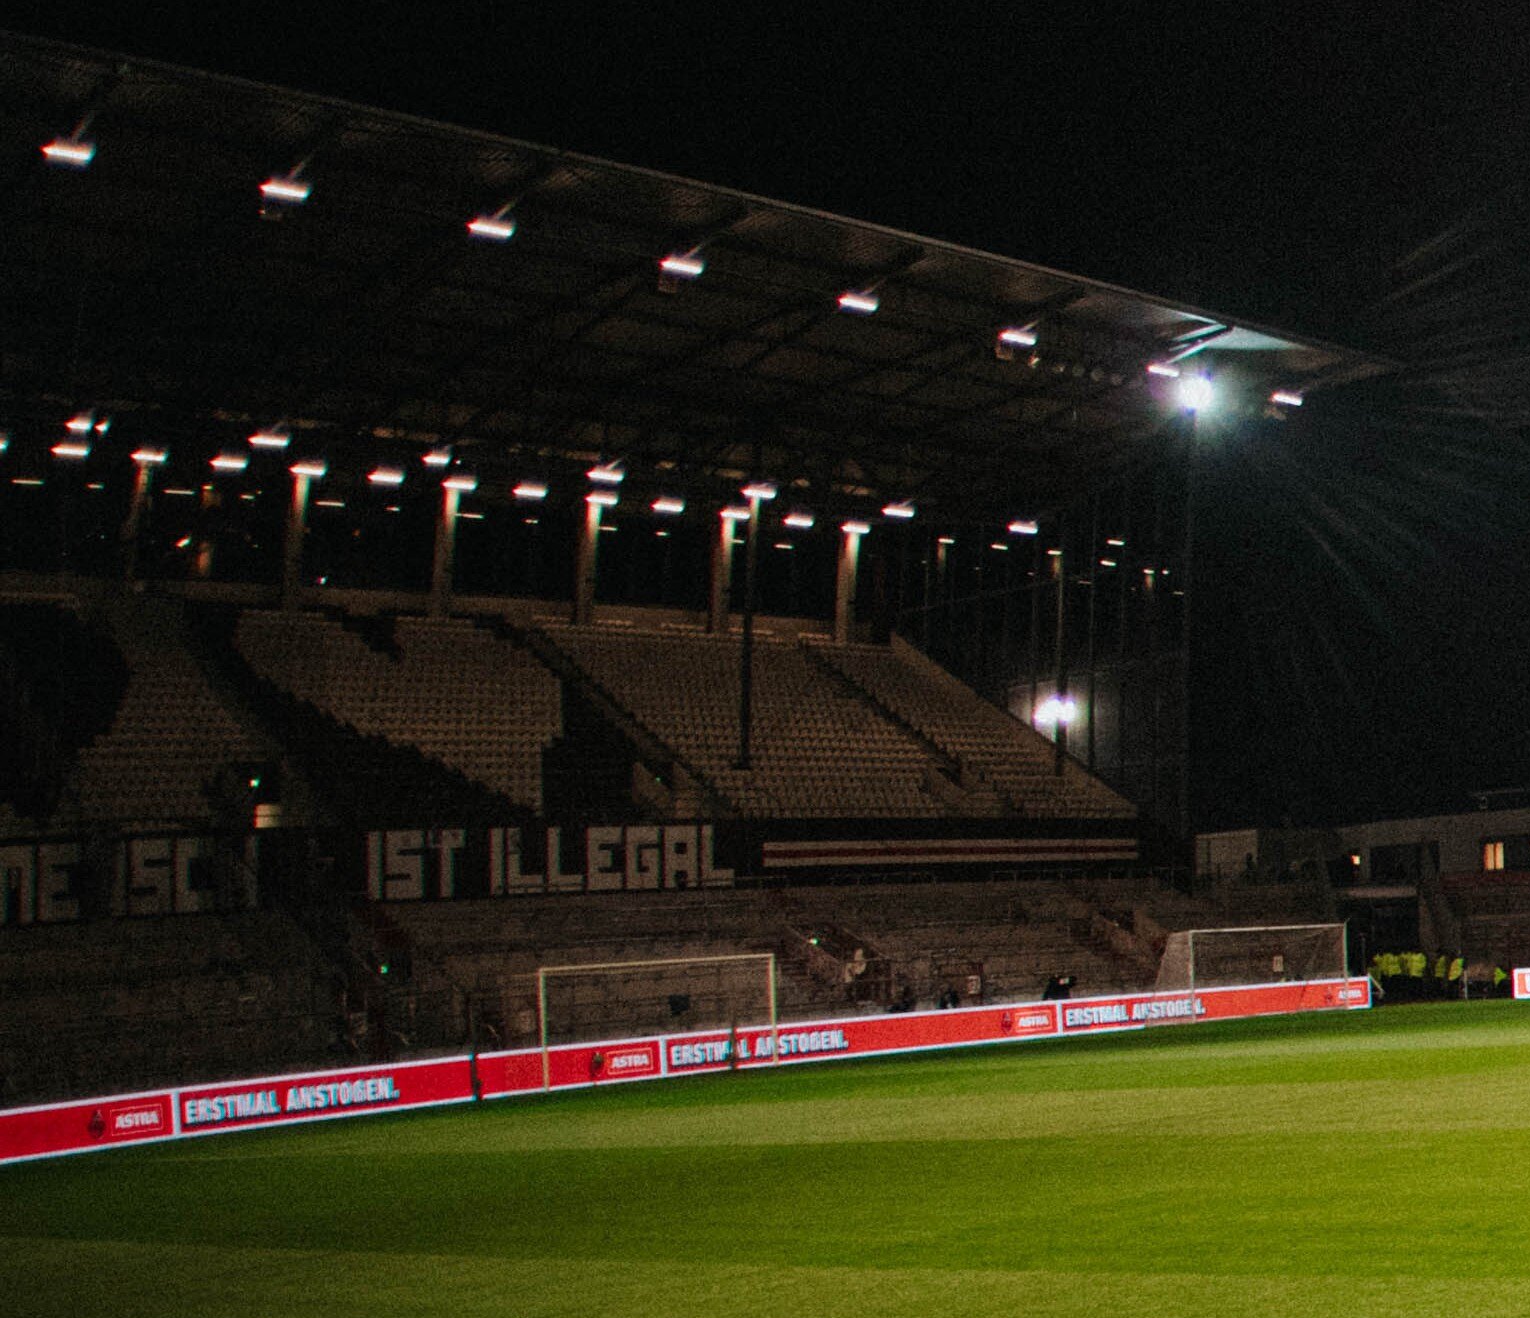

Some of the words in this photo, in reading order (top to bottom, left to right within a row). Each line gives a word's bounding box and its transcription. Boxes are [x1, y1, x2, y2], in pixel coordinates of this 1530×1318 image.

[364, 827, 468, 902] IST
[489, 824, 736, 896] ILLEGAL
[1065, 1004, 1129, 1028] ERSTMAL
[611, 1053, 649, 1070] ASTRA
[183, 1089, 282, 1126] ERSTMAL
[114, 1110, 160, 1131] ASTRA
